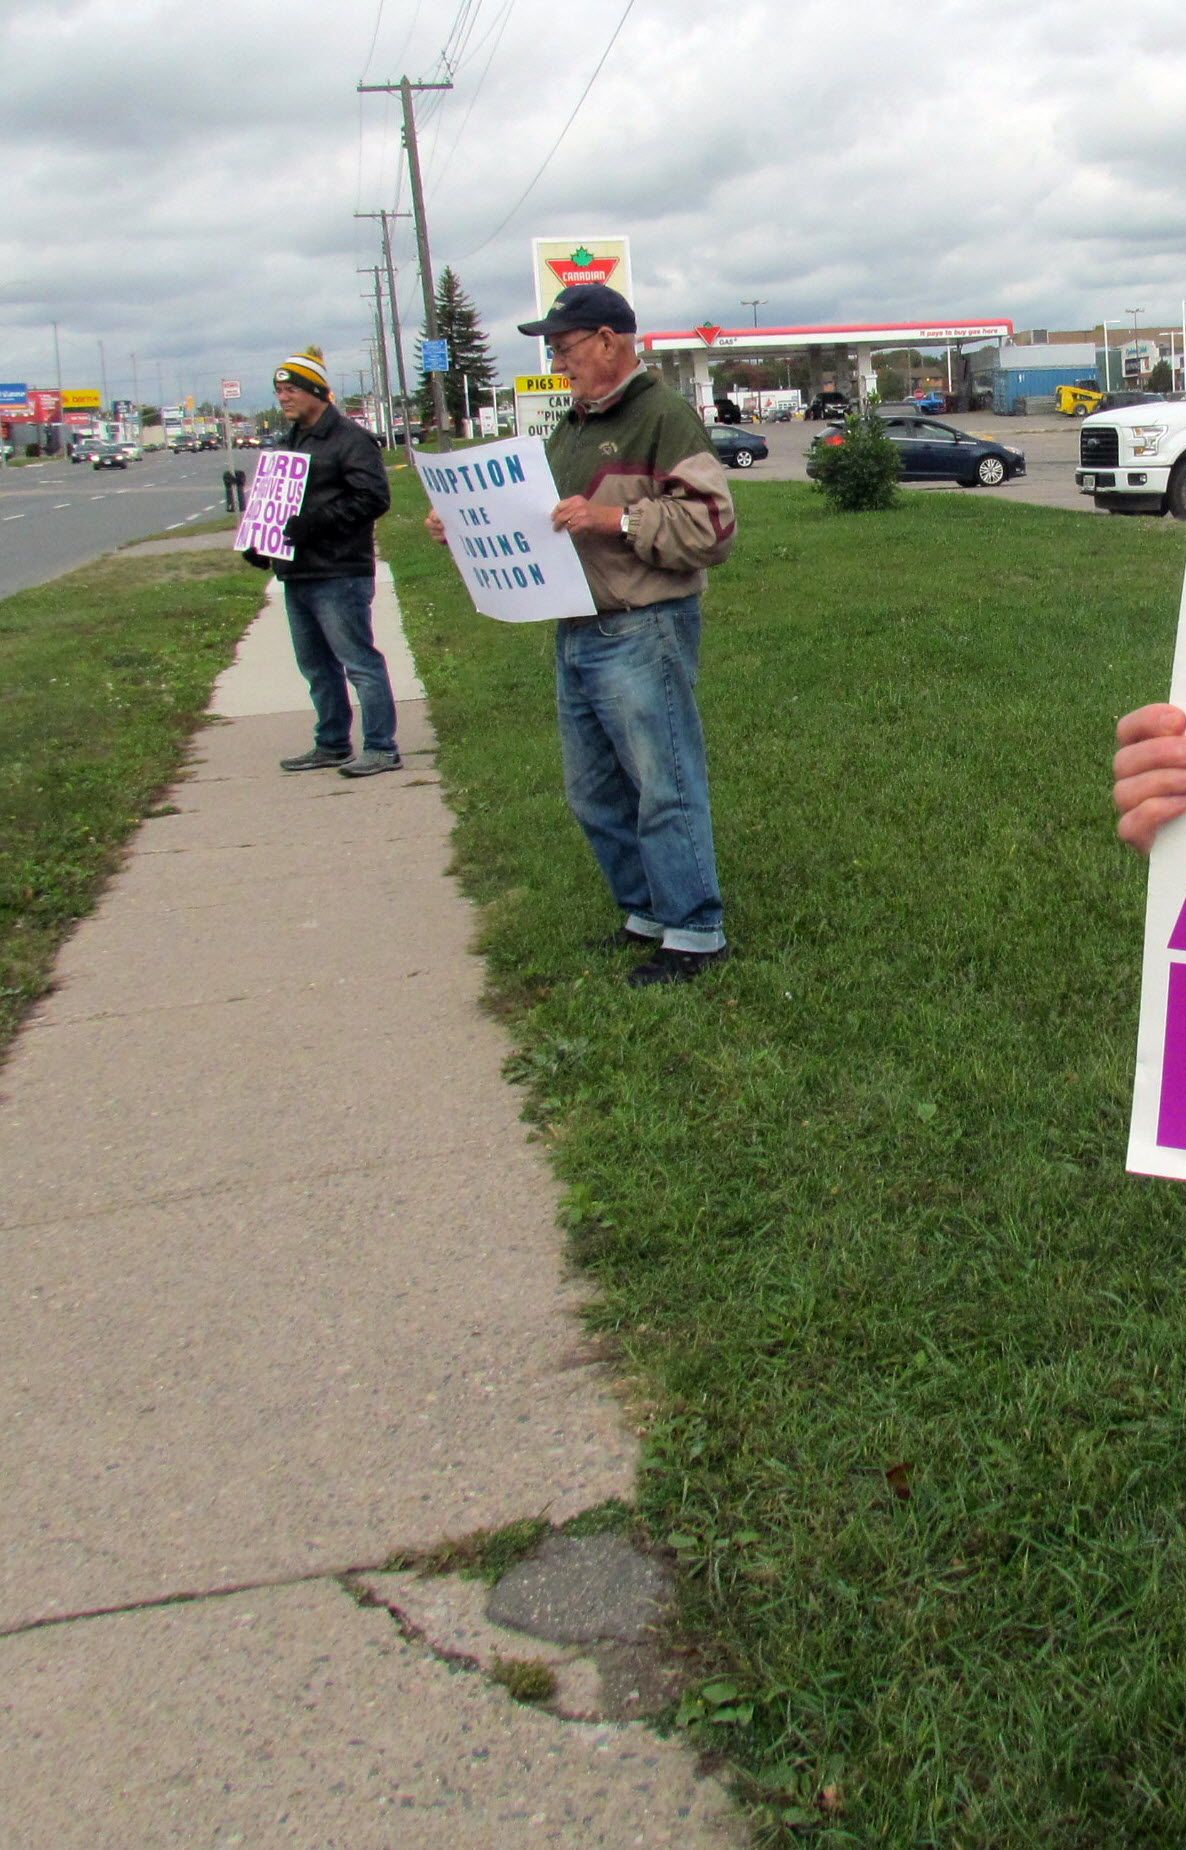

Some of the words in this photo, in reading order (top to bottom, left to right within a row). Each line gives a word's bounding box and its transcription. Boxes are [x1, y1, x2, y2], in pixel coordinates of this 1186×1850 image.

[562, 270, 606, 282] CANADIAN
[926, 330, 943, 338] pays
[953, 329, 967, 337] buy
[526, 378, 554, 390] PIGS
[537, 410, 565, 422] "PIN
[422, 454, 525, 494] ADOPTION
[287, 480, 304, 505] US
[459, 507, 491, 526] THE
[460, 531, 531, 559] LOVING
[473, 563, 546, 590] OPTION
